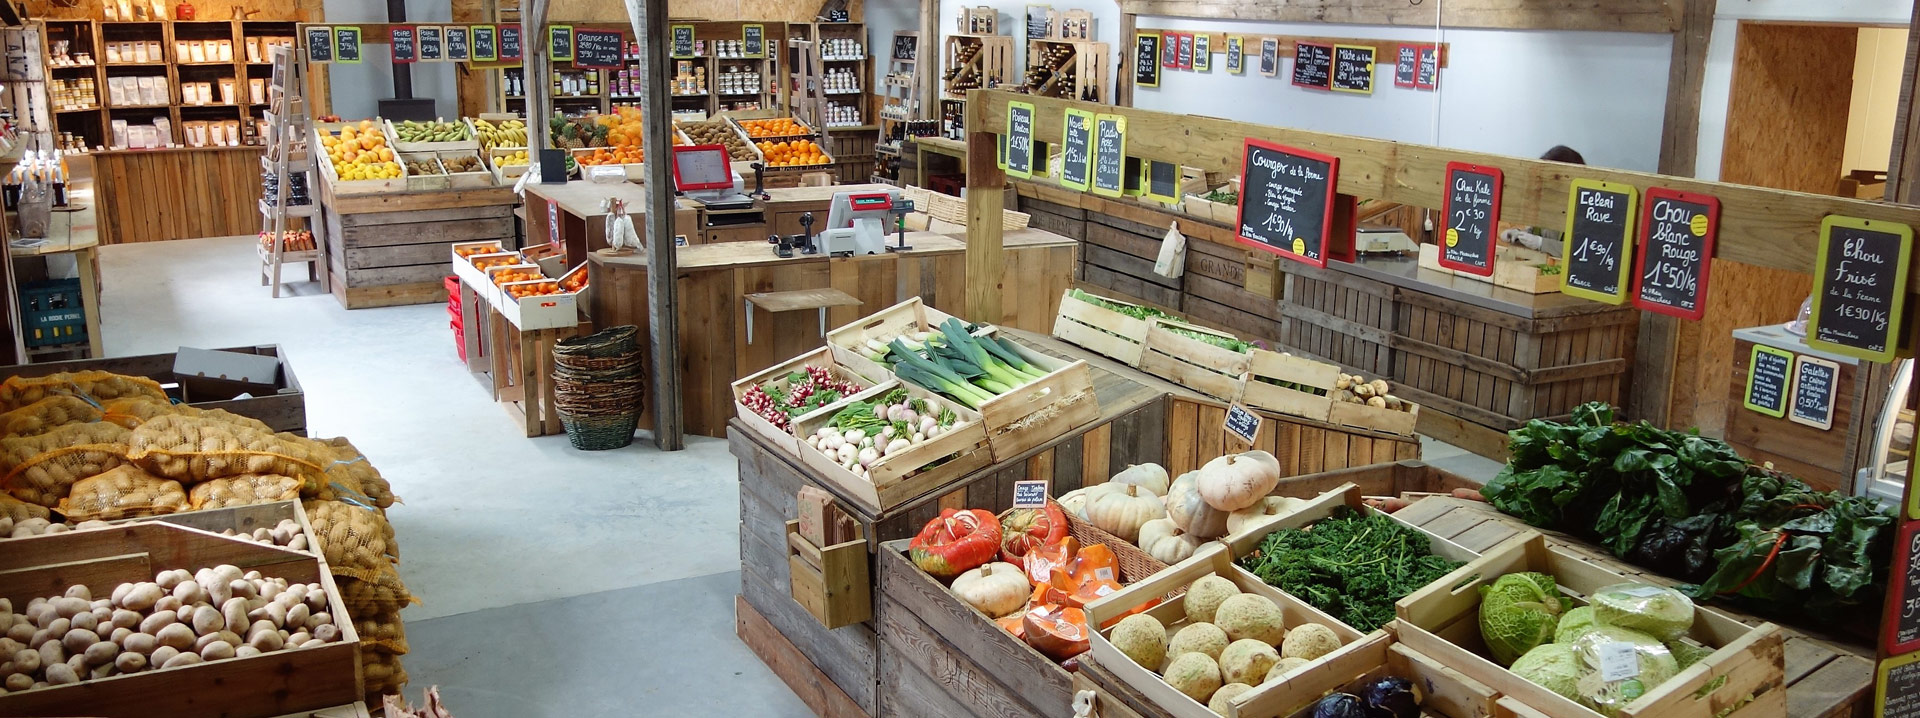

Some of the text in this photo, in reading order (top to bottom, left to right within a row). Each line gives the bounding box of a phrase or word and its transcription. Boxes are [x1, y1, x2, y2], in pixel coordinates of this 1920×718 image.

[1252, 150, 1324, 183] Courges de la ferme
[1456, 178, 1491, 195] Chou Kale
[1455, 193, 1492, 207] de la ferme
[1586, 206, 1613, 223] Rave
[1653, 201, 1691, 225] Chou
[1652, 222, 1690, 246] blanc
[1662, 245, 1699, 267] Rouge
[1843, 238, 1884, 264] Chou
[1835, 260, 1877, 286] Frisé
[1830, 286, 1881, 303] de la ferme
